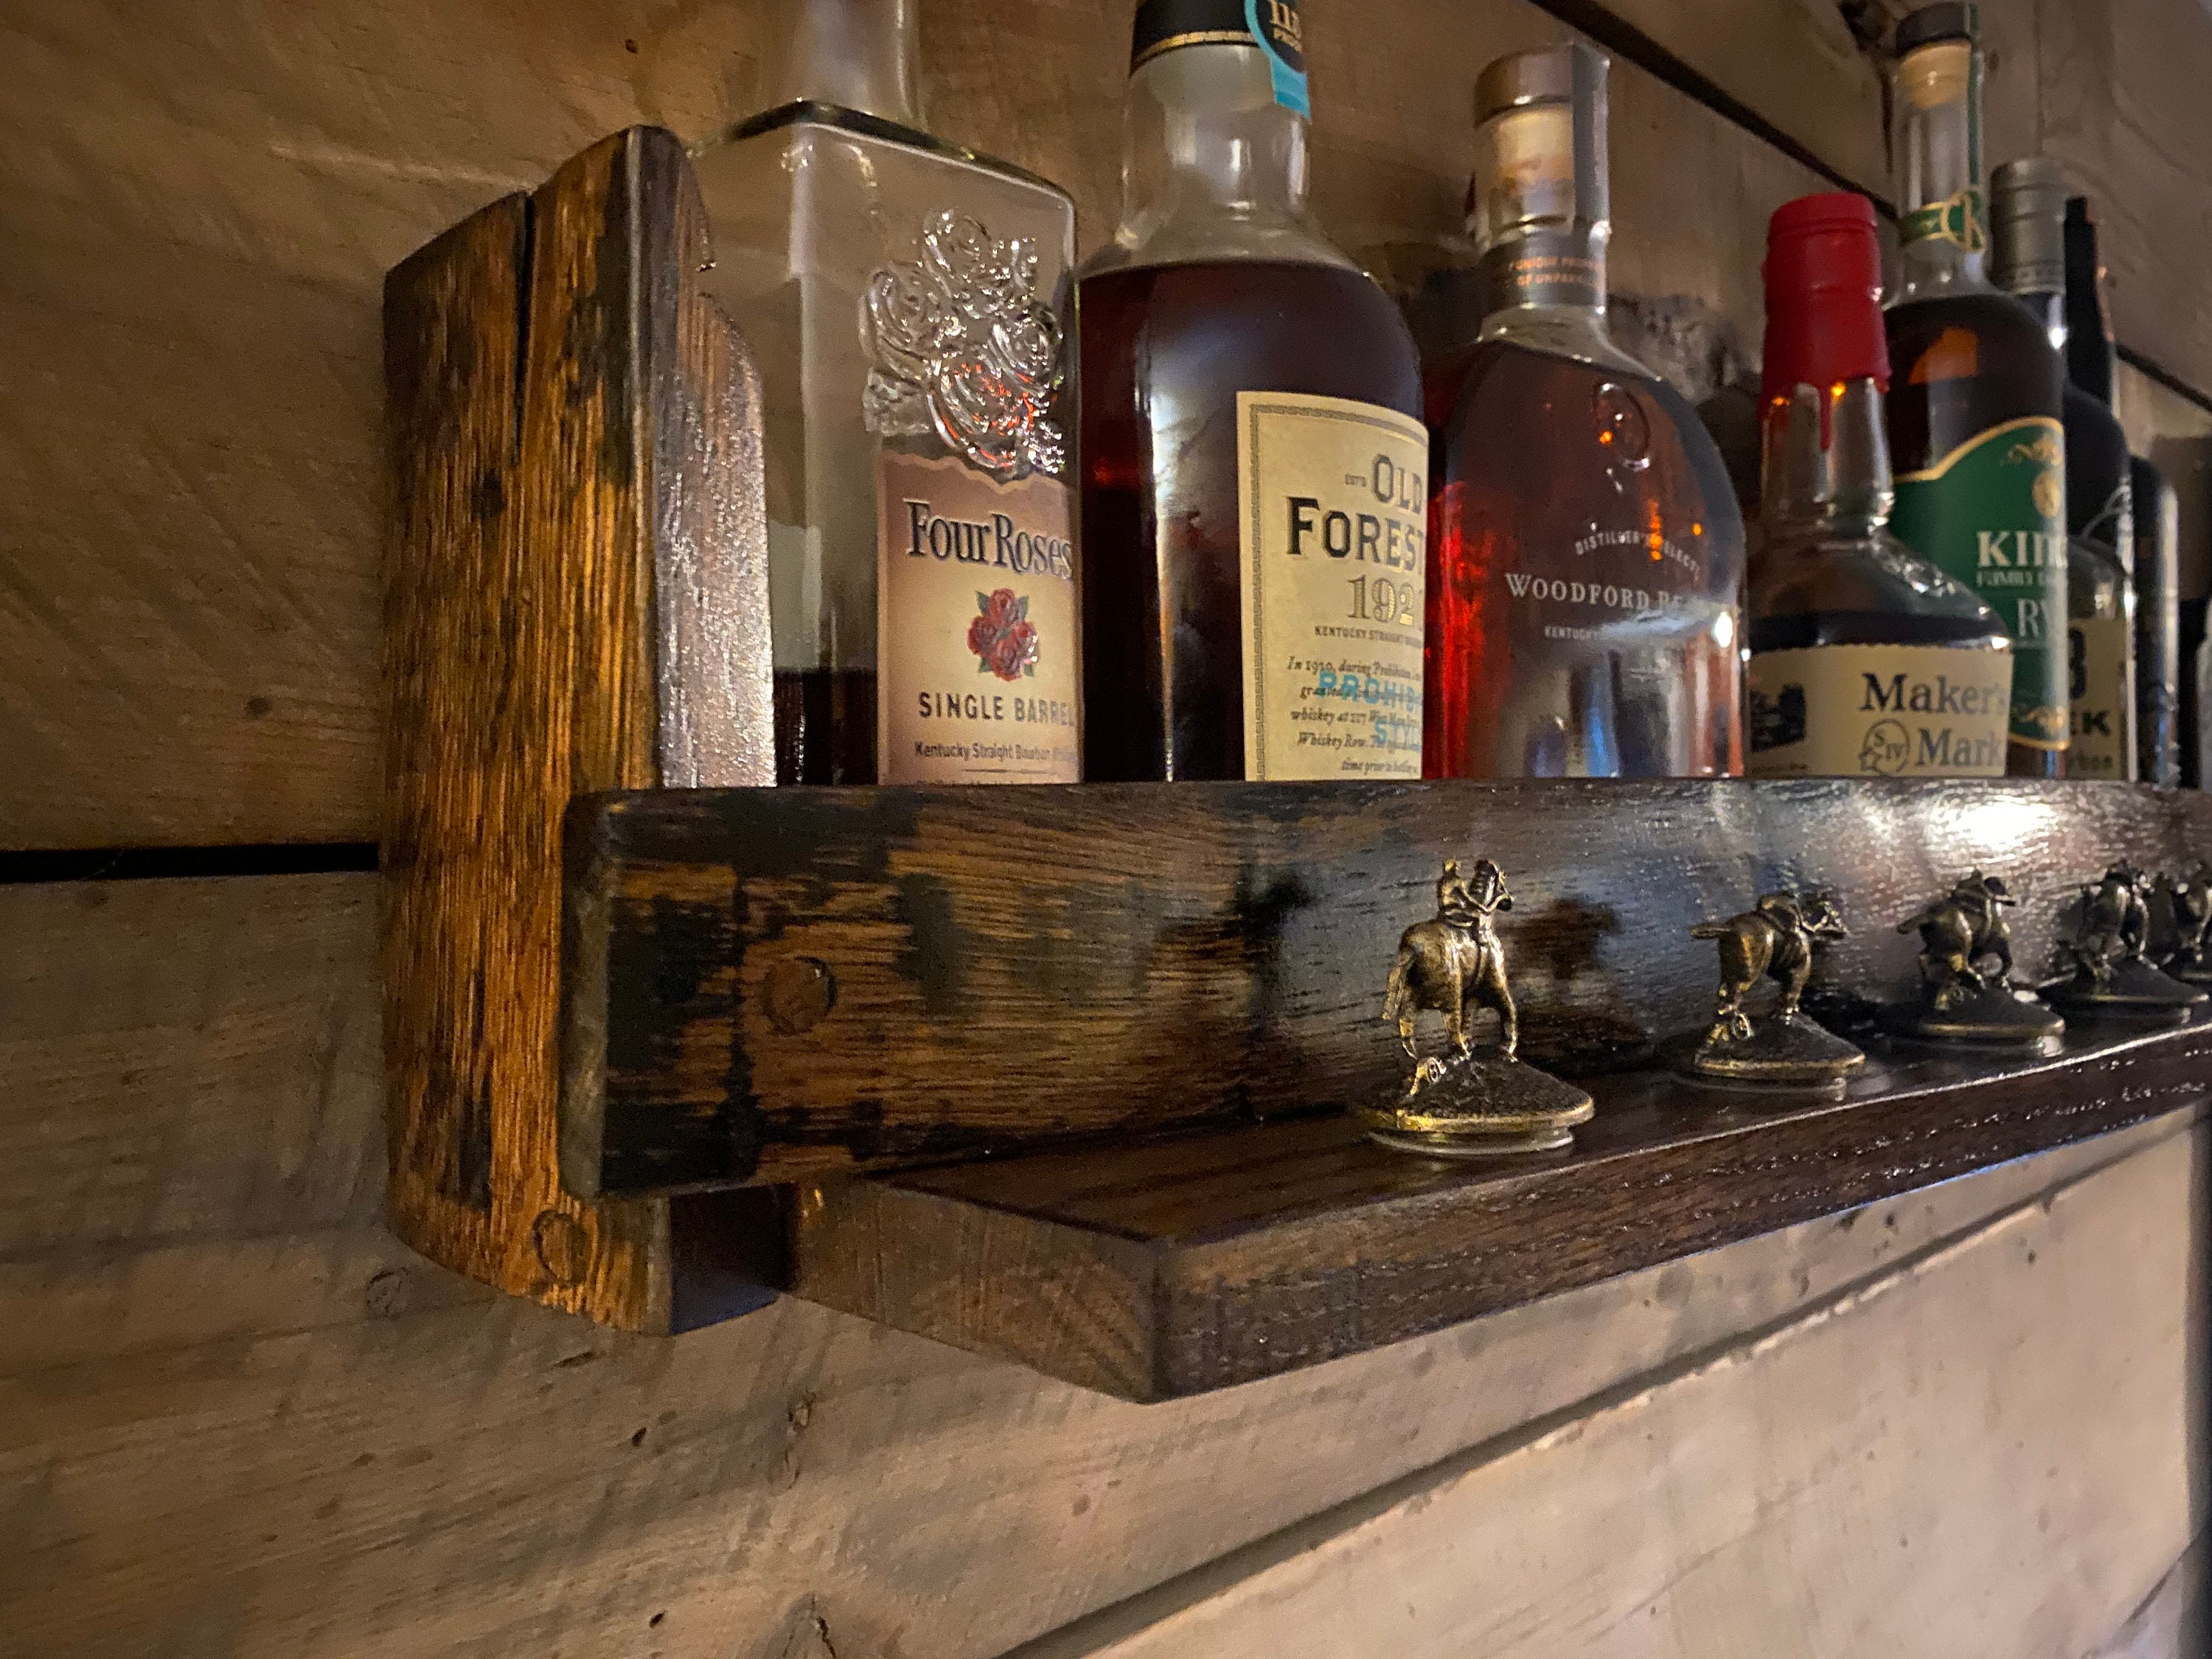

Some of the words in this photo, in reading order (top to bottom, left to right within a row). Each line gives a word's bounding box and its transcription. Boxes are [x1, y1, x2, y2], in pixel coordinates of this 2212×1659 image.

[1372, 453, 1424, 515] OLD
[904, 499, 991, 565] Four
[991, 512, 1073, 580] Roses
[1347, 574, 1425, 628] 192
[1505, 573, 1649, 610] WOODFORD
[1315, 626, 1366, 639] KENTUCKY
[1287, 655, 1302, 670] In
[918, 692, 1004, 721] SINGLE
[914, 740, 970, 761] Kentucky
[972, 742, 1013, 762] Straight
[1916, 728, 2003, 767] Mark
